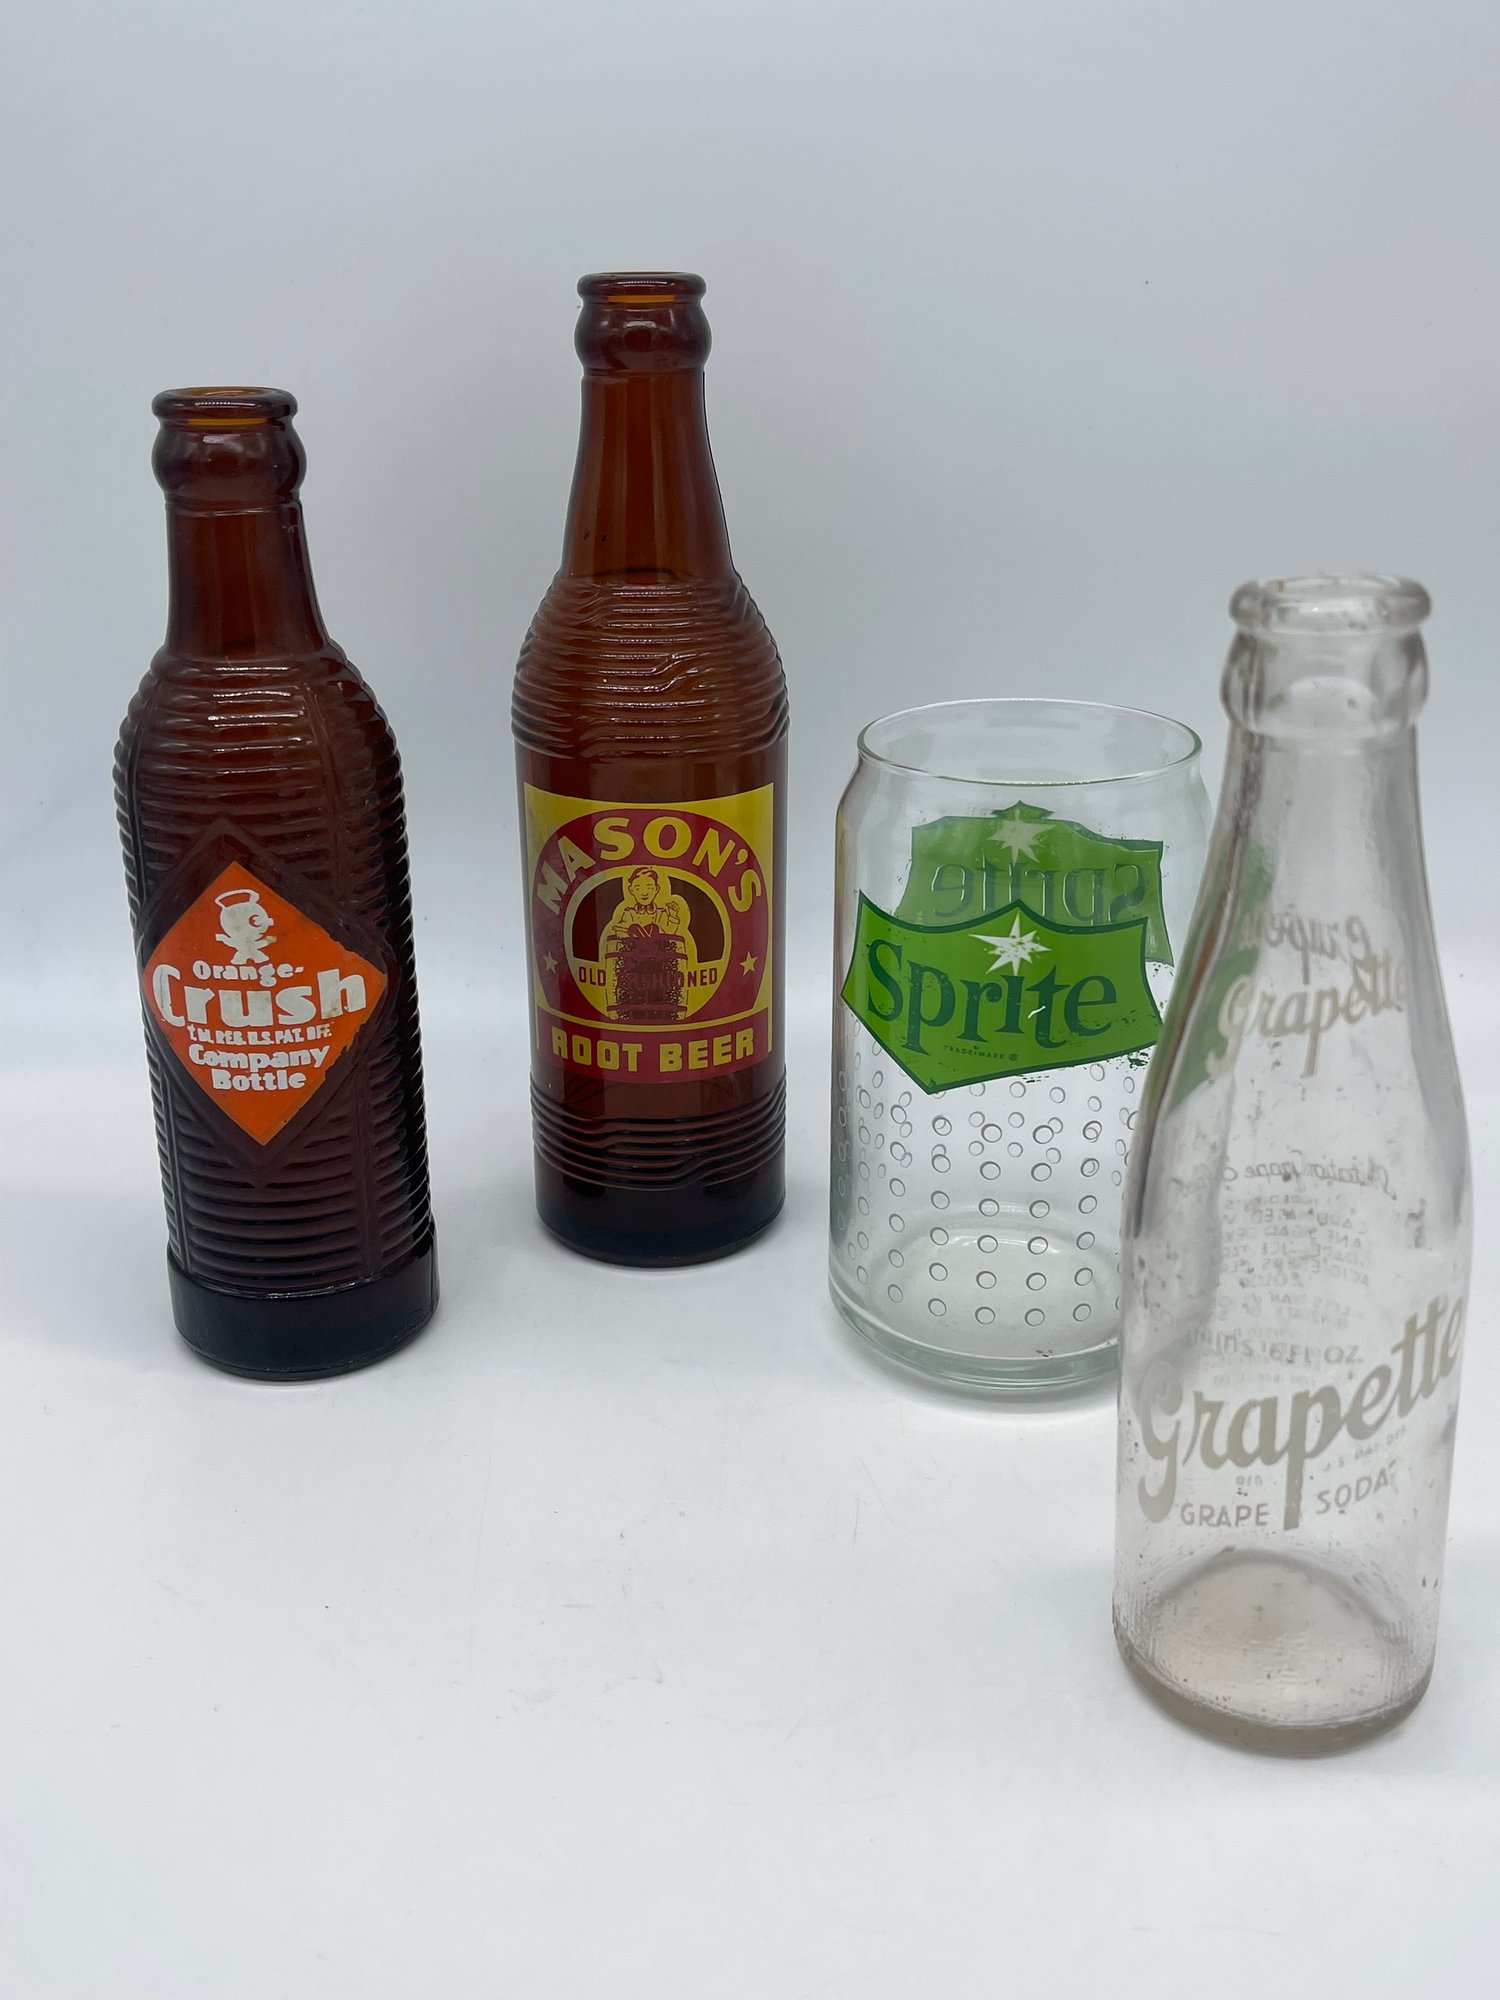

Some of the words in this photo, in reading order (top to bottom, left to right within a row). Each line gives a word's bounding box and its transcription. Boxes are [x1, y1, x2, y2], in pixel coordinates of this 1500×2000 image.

[537, 816, 762, 915] MASON'S
[153, 964, 367, 1028] Crush
[578, 968, 607, 987] OLD
[866, 938, 1118, 1056] Sprite
[1207, 950, 1403, 1079] Grapett
[188, 1044, 330, 1072] Company
[551, 1024, 643, 1073] ROOT
[659, 1027, 755, 1073] BEER
[211, 1069, 307, 1091] Bottle
[1137, 1292, 1465, 1531] Grapette
[1180, 1502, 1271, 1527] GRAPE
[1315, 1466, 1388, 1514] SODA
